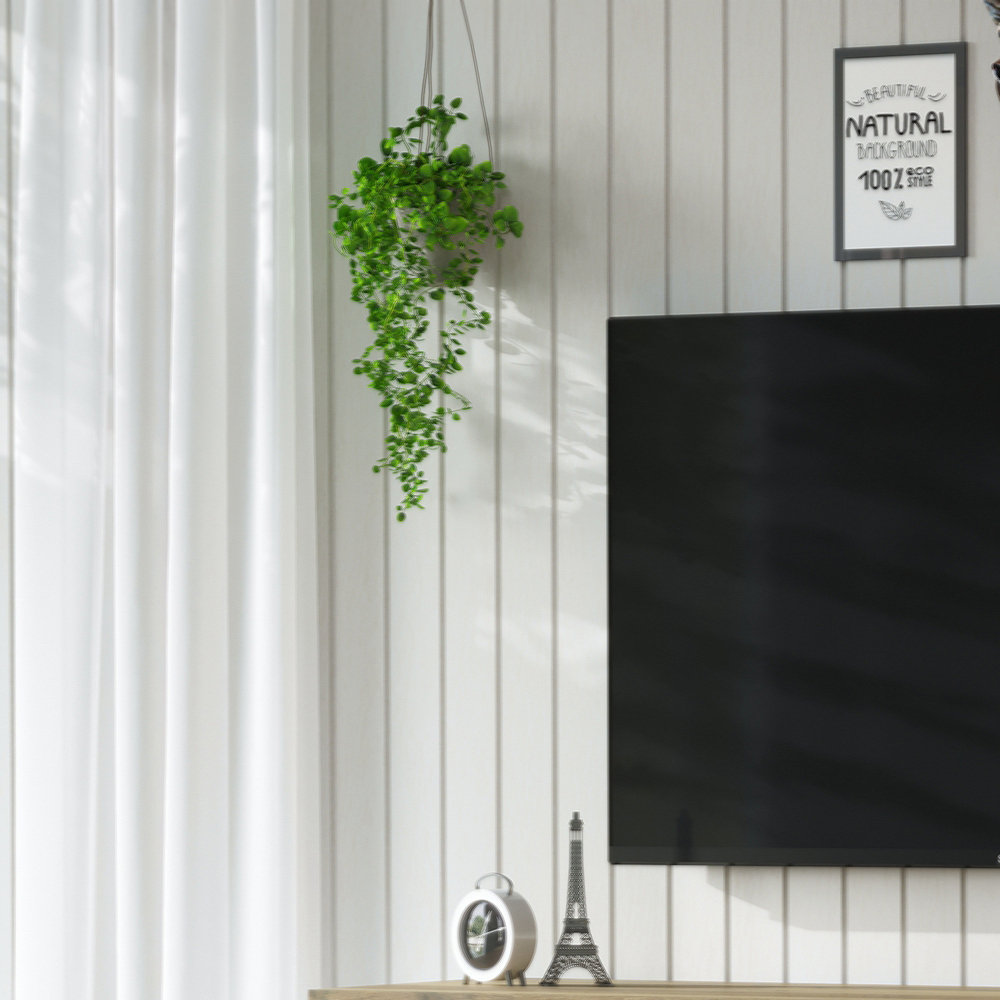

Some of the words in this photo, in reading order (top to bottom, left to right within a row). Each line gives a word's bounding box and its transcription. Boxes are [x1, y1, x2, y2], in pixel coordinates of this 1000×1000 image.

[863, 83, 927, 103] BEAUTIFUL
[846, 111, 953, 138] NATURAL
[855, 139, 938, 160] BACKGROUND
[857, 167, 904, 191] 100%
[906, 176, 934, 188] STYLE
